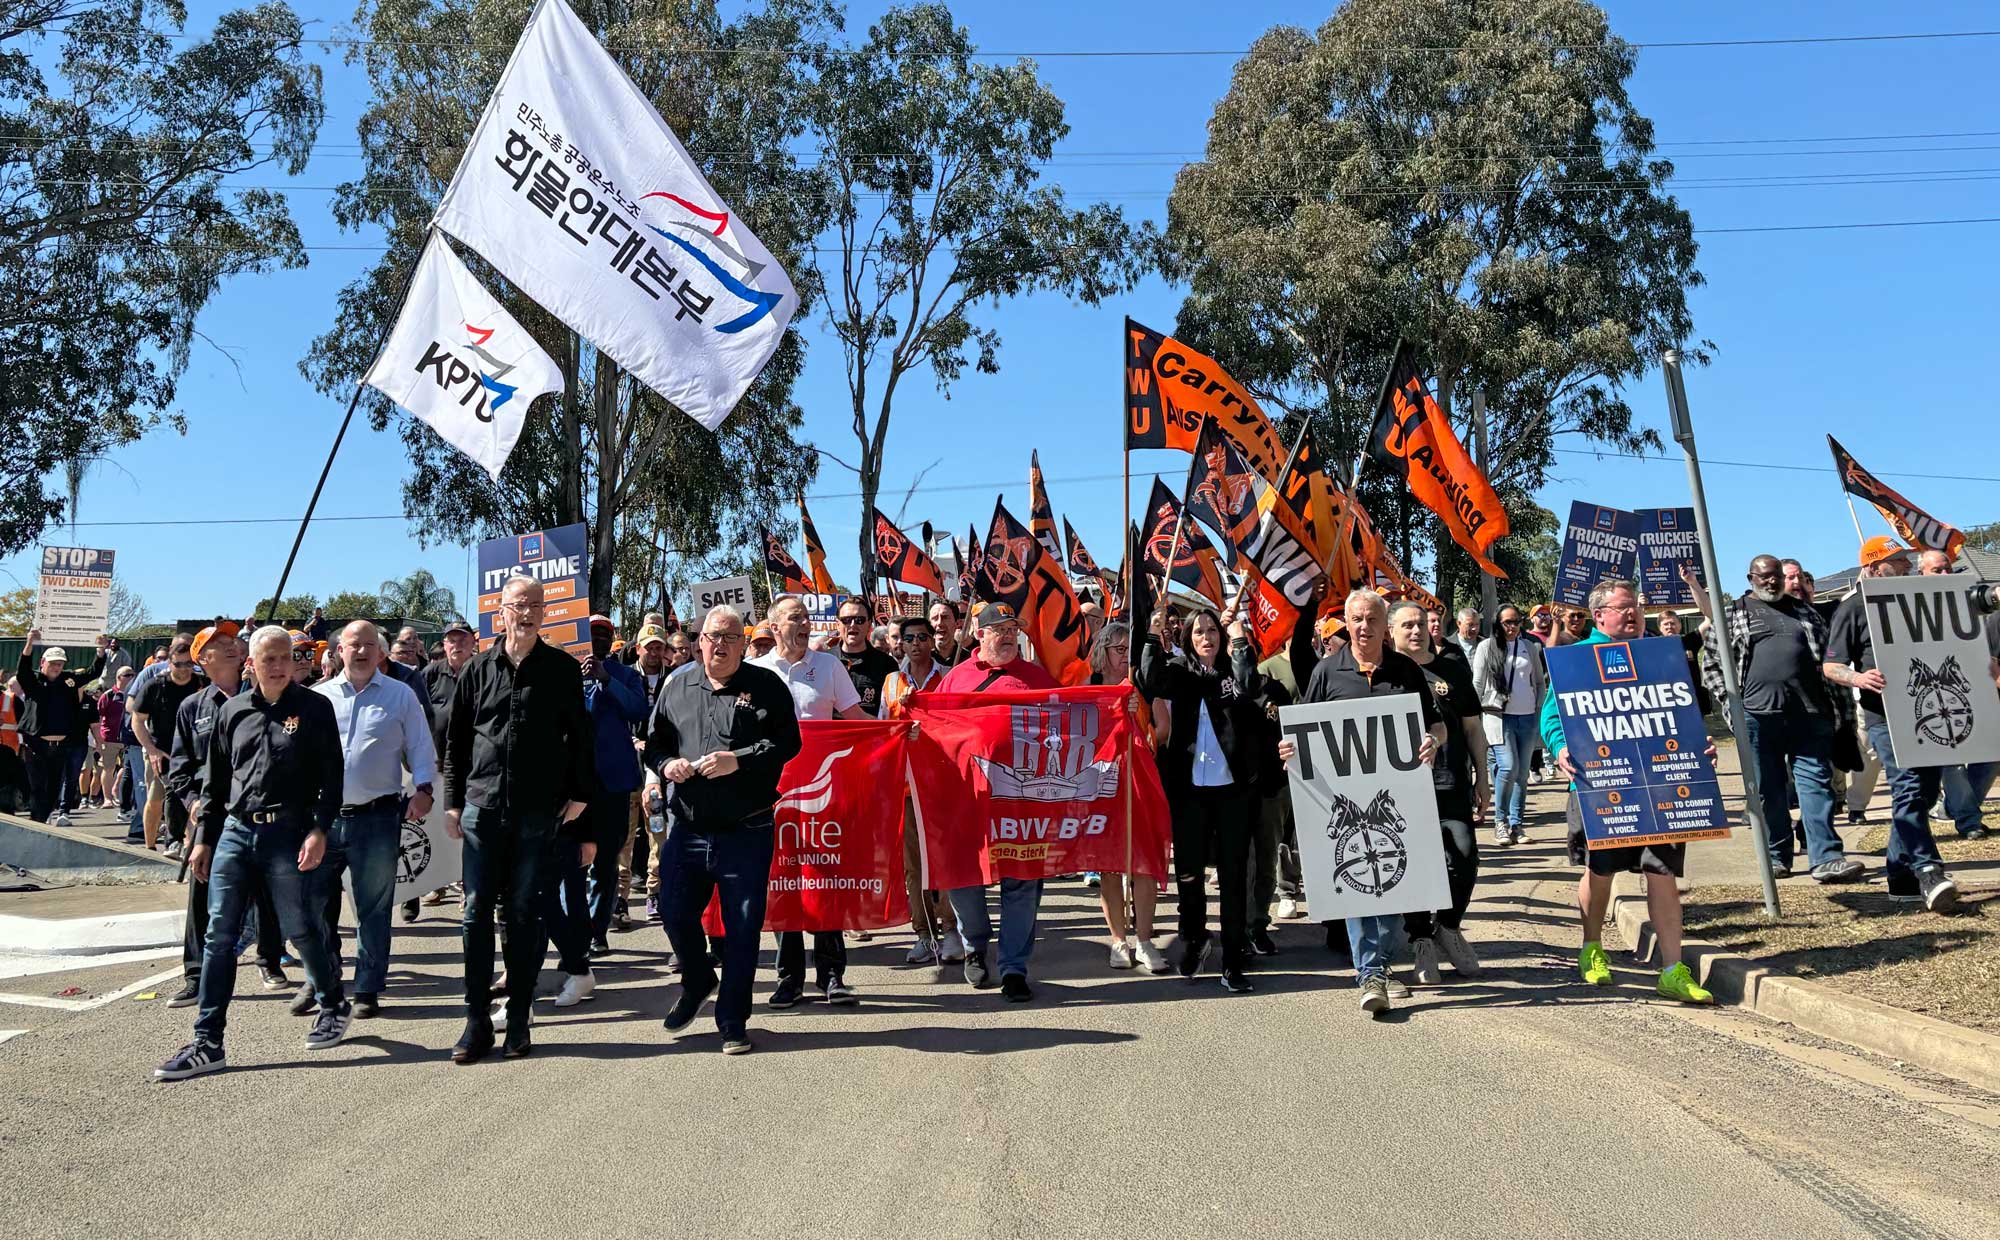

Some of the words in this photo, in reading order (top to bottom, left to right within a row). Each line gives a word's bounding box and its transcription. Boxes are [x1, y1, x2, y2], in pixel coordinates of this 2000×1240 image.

[517, 102, 563, 153] 민주노총
[564, 143, 641, 220] 공공운수노조
[415, 341, 495, 423] KPTU
[1569, 526, 1637, 552] TRUCKIES
[44, 547, 98, 570] STOP
[1577, 542, 1622, 565] WANT!
[1650, 545, 1693, 559] WANT!
[528, 555, 580, 580] TIME
[41, 576, 65, 586] TWU
[69, 578, 110, 589] CLAIMS
[544, 587, 567, 595] PLOYER.
[702, 588, 745, 609] SAFE
[1866, 590, 1981, 645] TWU
[1607, 665, 1629, 674] ALDI
[1558, 682, 1693, 717] TRUCKIES
[1586, 711, 1678, 742] WANT!
[1283, 712, 1423, 781] TWU
[1652, 754, 1668, 762] ALDI
[1586, 767, 1634, 778] RESPONSIBLE
[1652, 762, 1700, 772] RESPONSIBLE
[1592, 778, 1632, 788] EMPLOYER.
[1666, 772, 1692, 781] CLIENT.
[1685, 799, 1713, 807] COMMIT
[1602, 815, 1638, 824] WORKERS
[1676, 809, 1710, 818] INDUSTRY
[779, 816, 842, 849] nite
[1058, 815, 1108, 839] BB
[1608, 827, 1614, 835] A
[1668, 819, 1712, 829] STANDARDS.
[1372, 824, 1400, 845] WORKERS
[1020, 845, 1045, 858] sterk
[1336, 826, 1358, 864] TRANSPORT
[778, 855, 796, 866] the
[798, 853, 840, 865] UNION
[769, 875, 883, 894] nitetheunion.org
[1342, 873, 1364, 892] UNION
[1391, 868, 1405, 884] NSW
